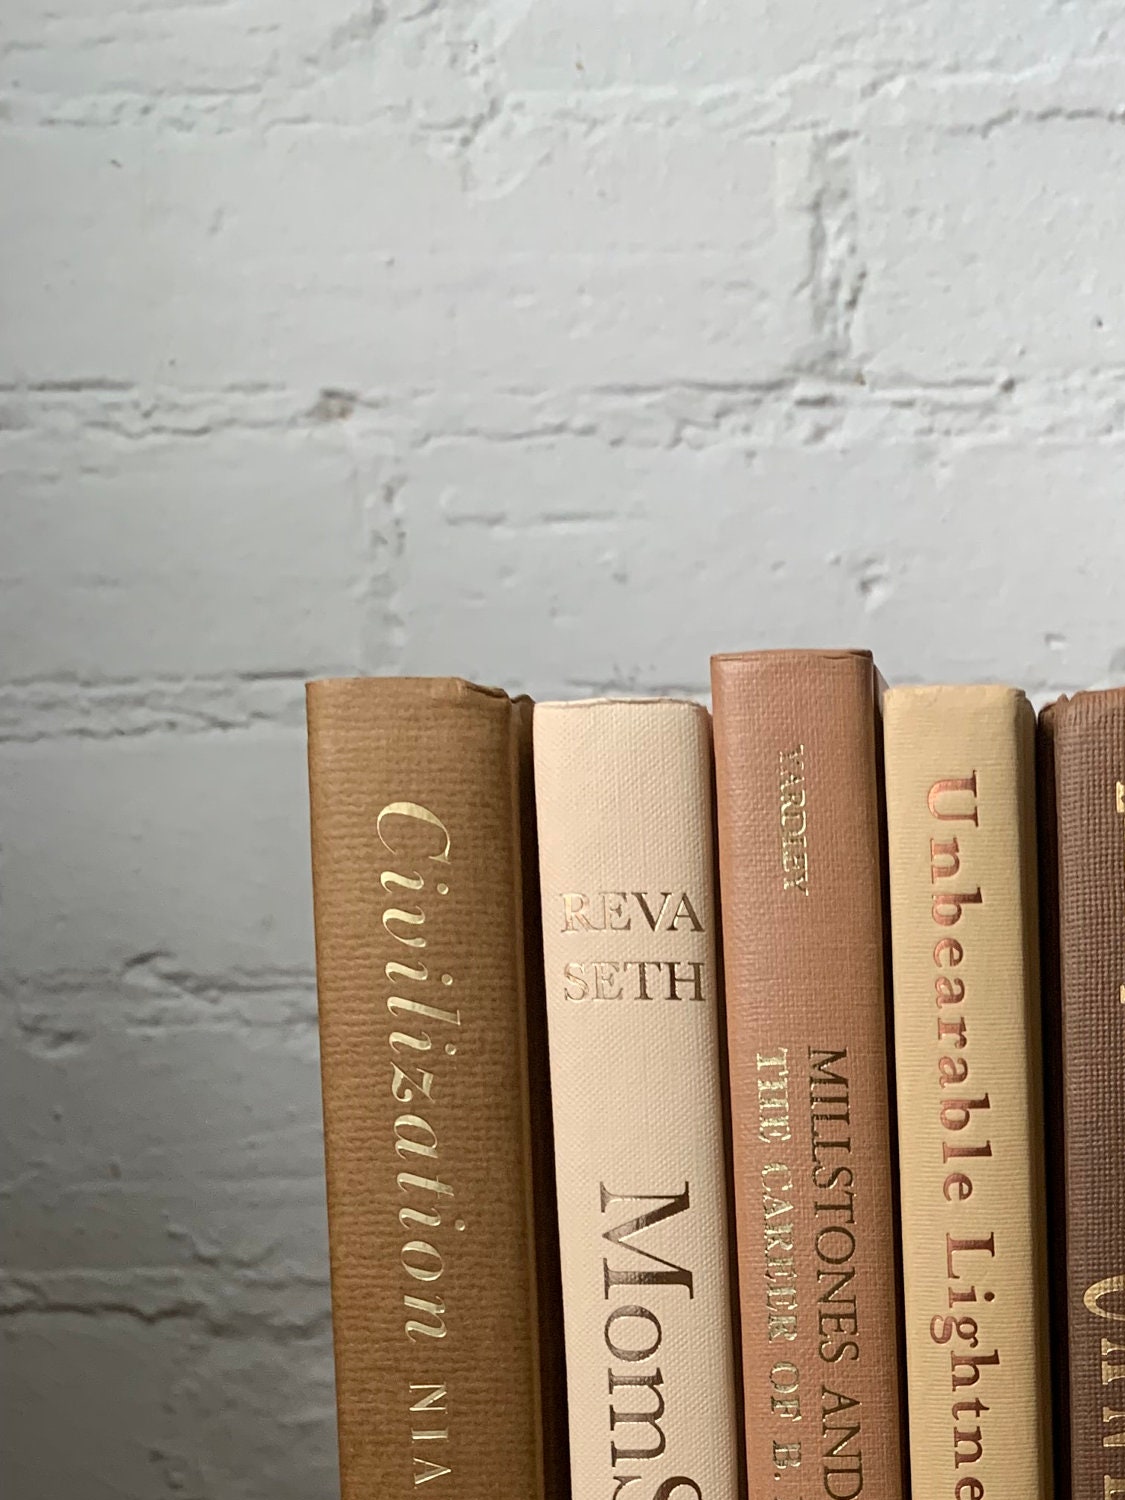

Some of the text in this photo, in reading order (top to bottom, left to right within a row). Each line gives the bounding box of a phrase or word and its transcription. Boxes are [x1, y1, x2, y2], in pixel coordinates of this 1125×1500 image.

[779, 744, 809, 896] YARDLEY
[560, 891, 705, 935] REVA
[563, 961, 706, 1002] SETH
[927, 769, 994, 1202] Unbearable
[376, 801, 468, 1343] Civilization
[756, 1046, 792, 1143] THE
[760, 1162, 799, 1345] CAREER
[808, 1045, 861, 1364] MILLSTONES
[770, 1361, 802, 1422] OF
[771, 1439, 801, 1481] B.
